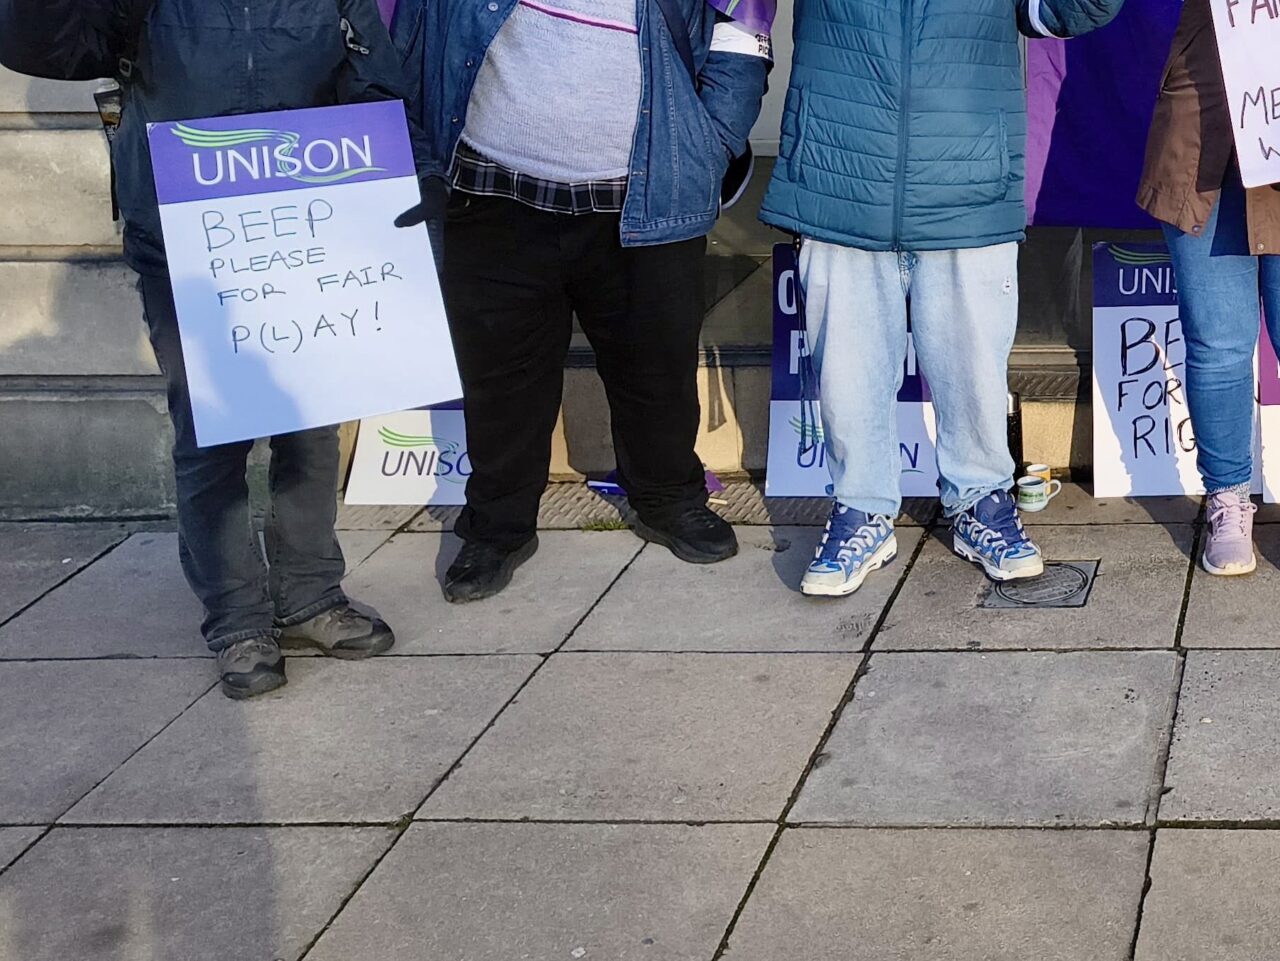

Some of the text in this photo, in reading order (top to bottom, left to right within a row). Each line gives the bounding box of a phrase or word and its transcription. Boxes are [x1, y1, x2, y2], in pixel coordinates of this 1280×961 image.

[192, 135, 373, 185] UNISON
[202, 199, 333, 252] BEEP
[209, 247, 326, 278] PLEASE
[1118, 267, 1178, 294] UNI
[218, 262, 402, 306] FOR FAIR
[231, 301, 382, 353] P(L)AY!
[1118, 378, 1182, 411] FOR
[381, 451, 473, 476] UNISO
